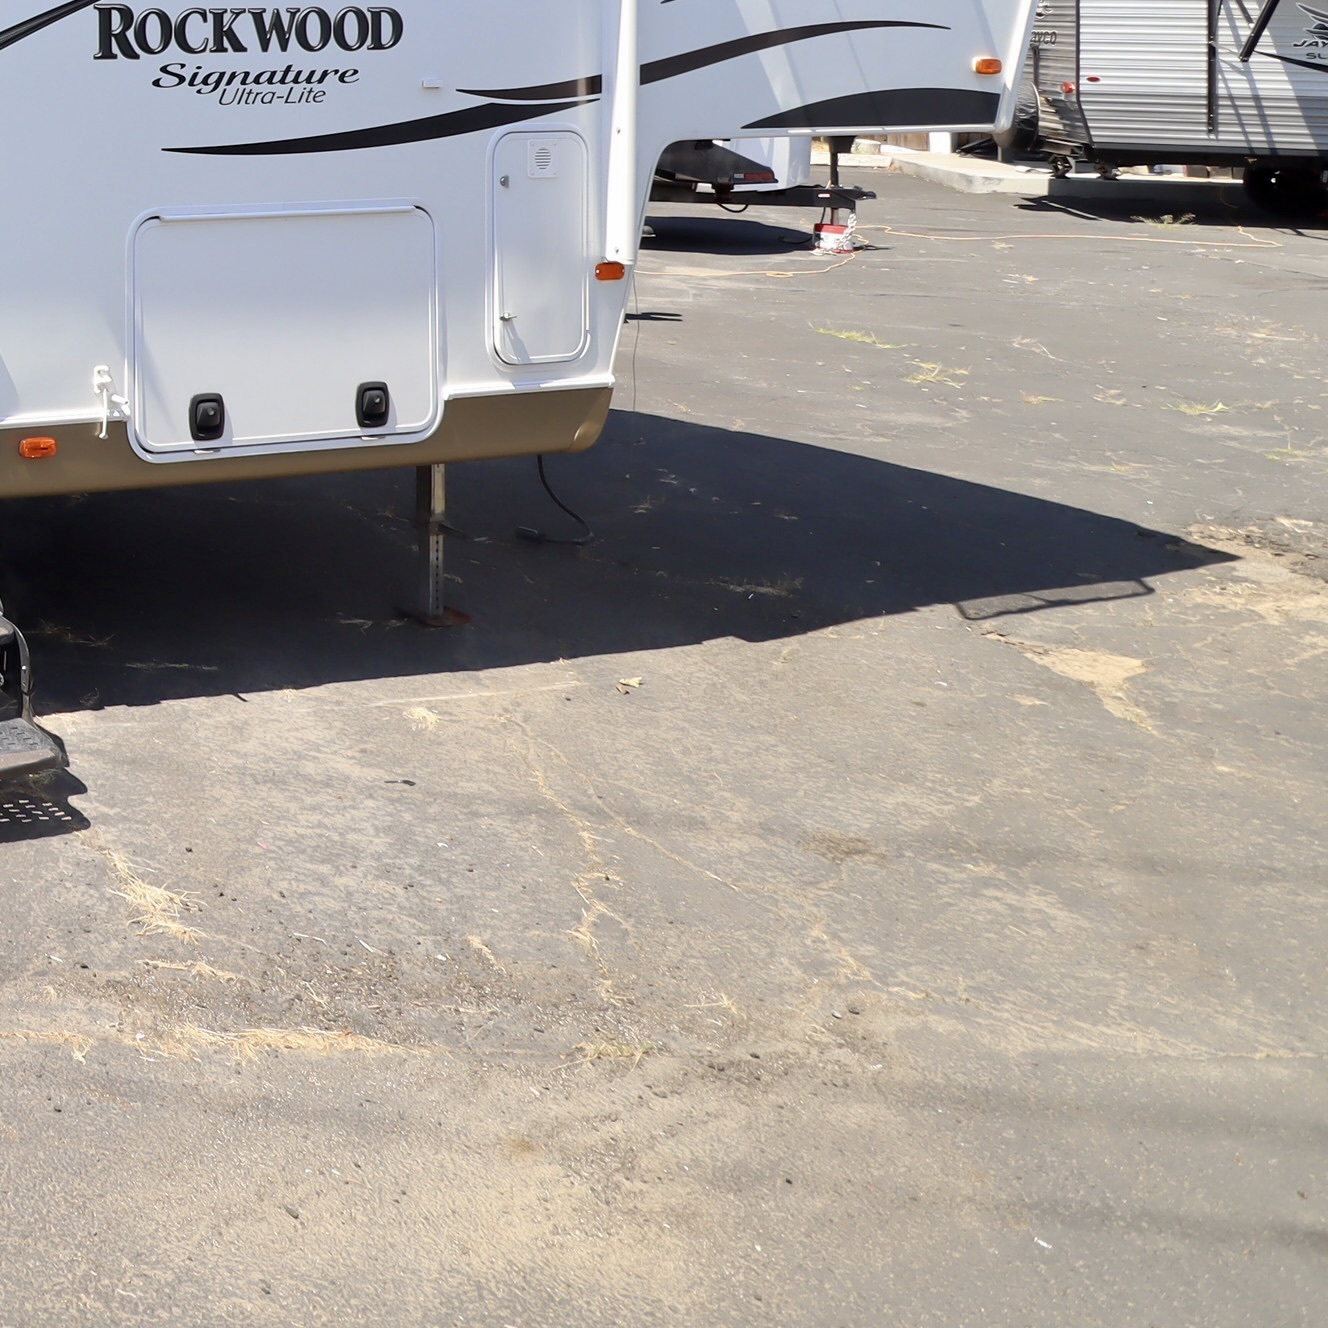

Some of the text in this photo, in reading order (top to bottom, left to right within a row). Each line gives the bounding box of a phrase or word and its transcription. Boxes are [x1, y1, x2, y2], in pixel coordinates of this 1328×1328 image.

[93, 3, 404, 60] ROCKWOOD
[1029, 30, 1057, 45] ayco
[151, 62, 360, 95] Signature
[218, 86, 327, 106] Ultra-Lite
